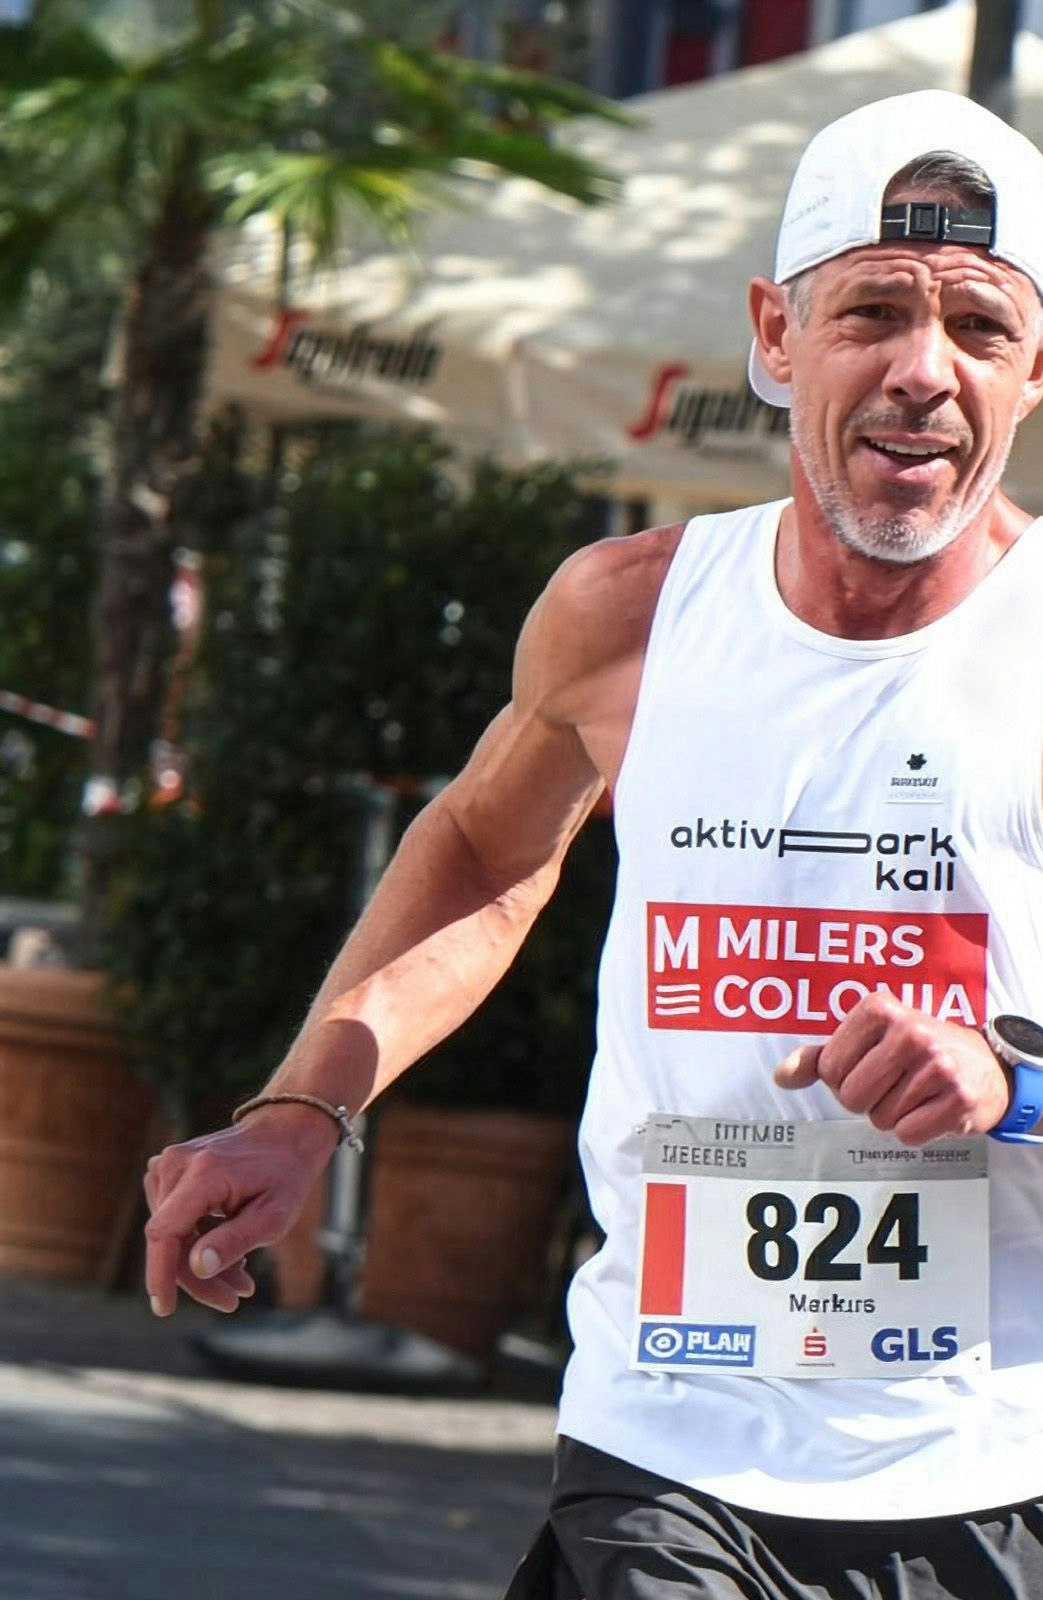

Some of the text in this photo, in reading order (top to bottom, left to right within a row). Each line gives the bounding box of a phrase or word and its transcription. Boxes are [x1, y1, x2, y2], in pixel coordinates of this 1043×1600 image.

[875, 861, 955, 892] kall
[717, 916, 925, 967] MILERS
[746, 1191, 929, 1281] 824
[871, 1326, 959, 1363] GLS
